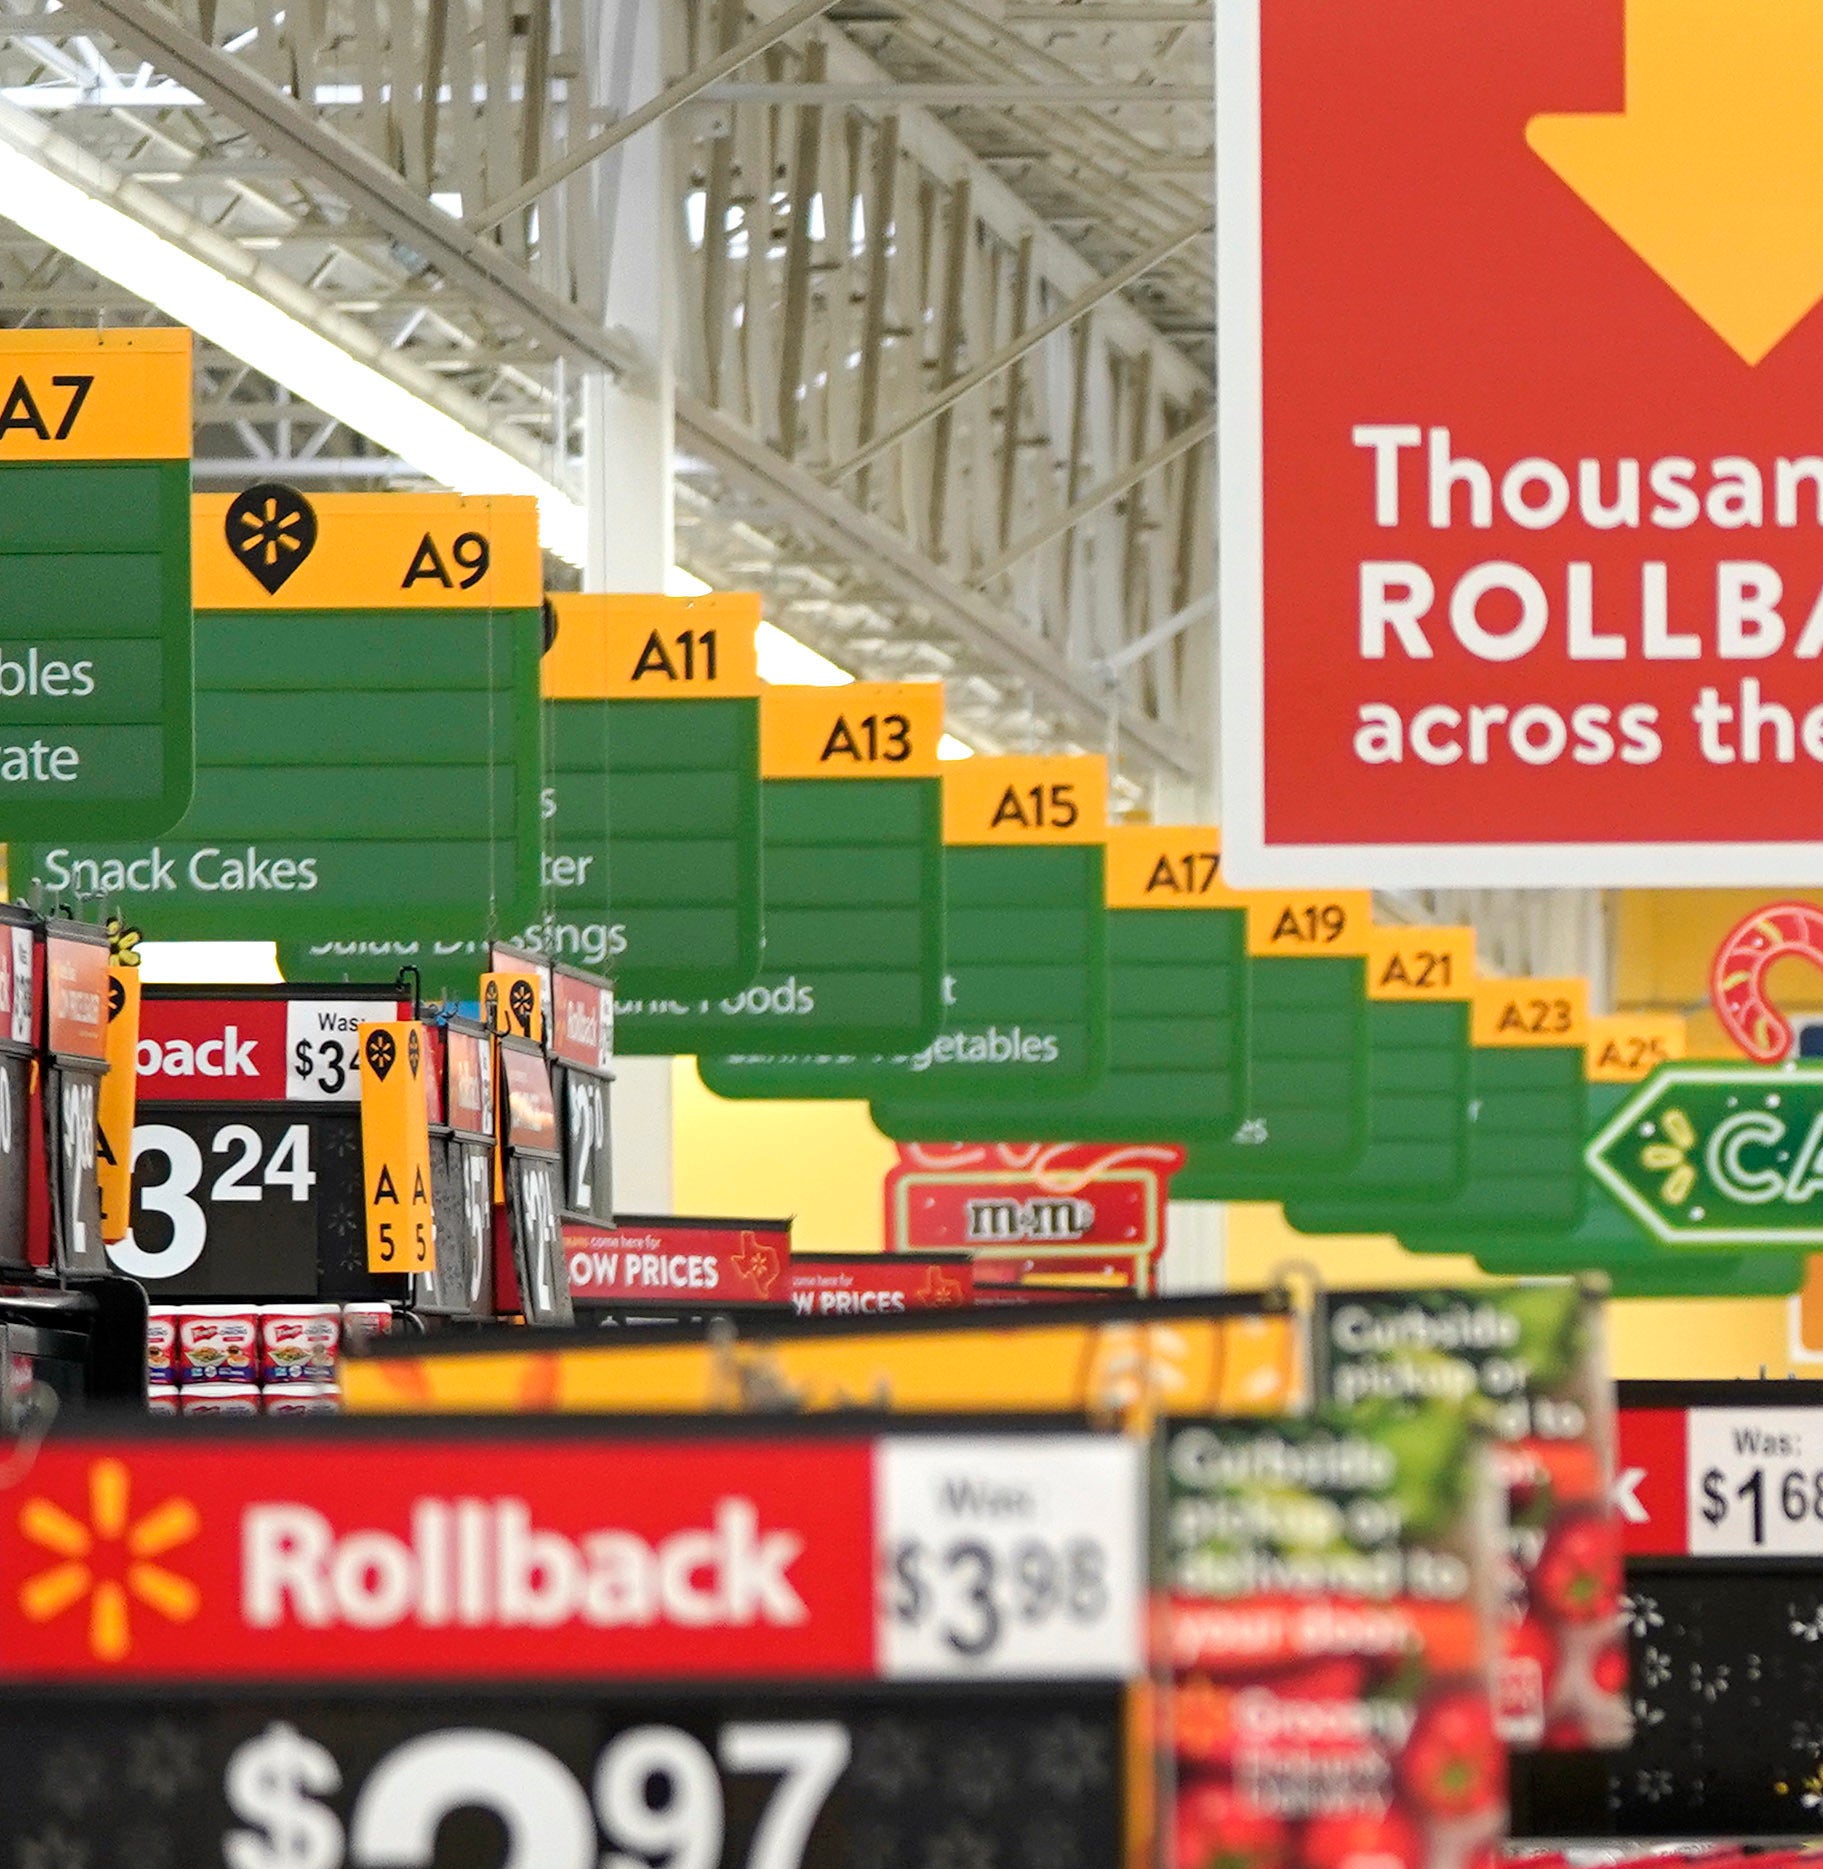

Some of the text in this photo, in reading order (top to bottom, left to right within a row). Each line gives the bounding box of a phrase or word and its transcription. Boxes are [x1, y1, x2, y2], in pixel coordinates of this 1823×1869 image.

[0, 376, 94, 441] A7
[400, 534, 490, 589] A9
[631, 631, 718, 681] A11
[821, 715, 912, 763] A13
[1353, 701, 1662, 765] across
[991, 785, 1078, 828] A15
[45, 849, 318, 891] Snack Cakes
[1145, 854, 1221, 895] A17
[1272, 905, 1344, 944] A19
[1380, 953, 1451, 988] A21
[1500, 1002, 1572, 1033] A23
[375, 1165, 399, 1205] A
[412, 1166, 427, 1205] A
[380, 1223, 395, 1262] 5
[416, 1225, 427, 1262] 5
[566, 1254, 718, 1290] OW PRICES
[820, 1292, 905, 1317] PRICES
[1731, 1429, 1803, 1457] Was:
[241, 1498, 808, 1630] Rollback
